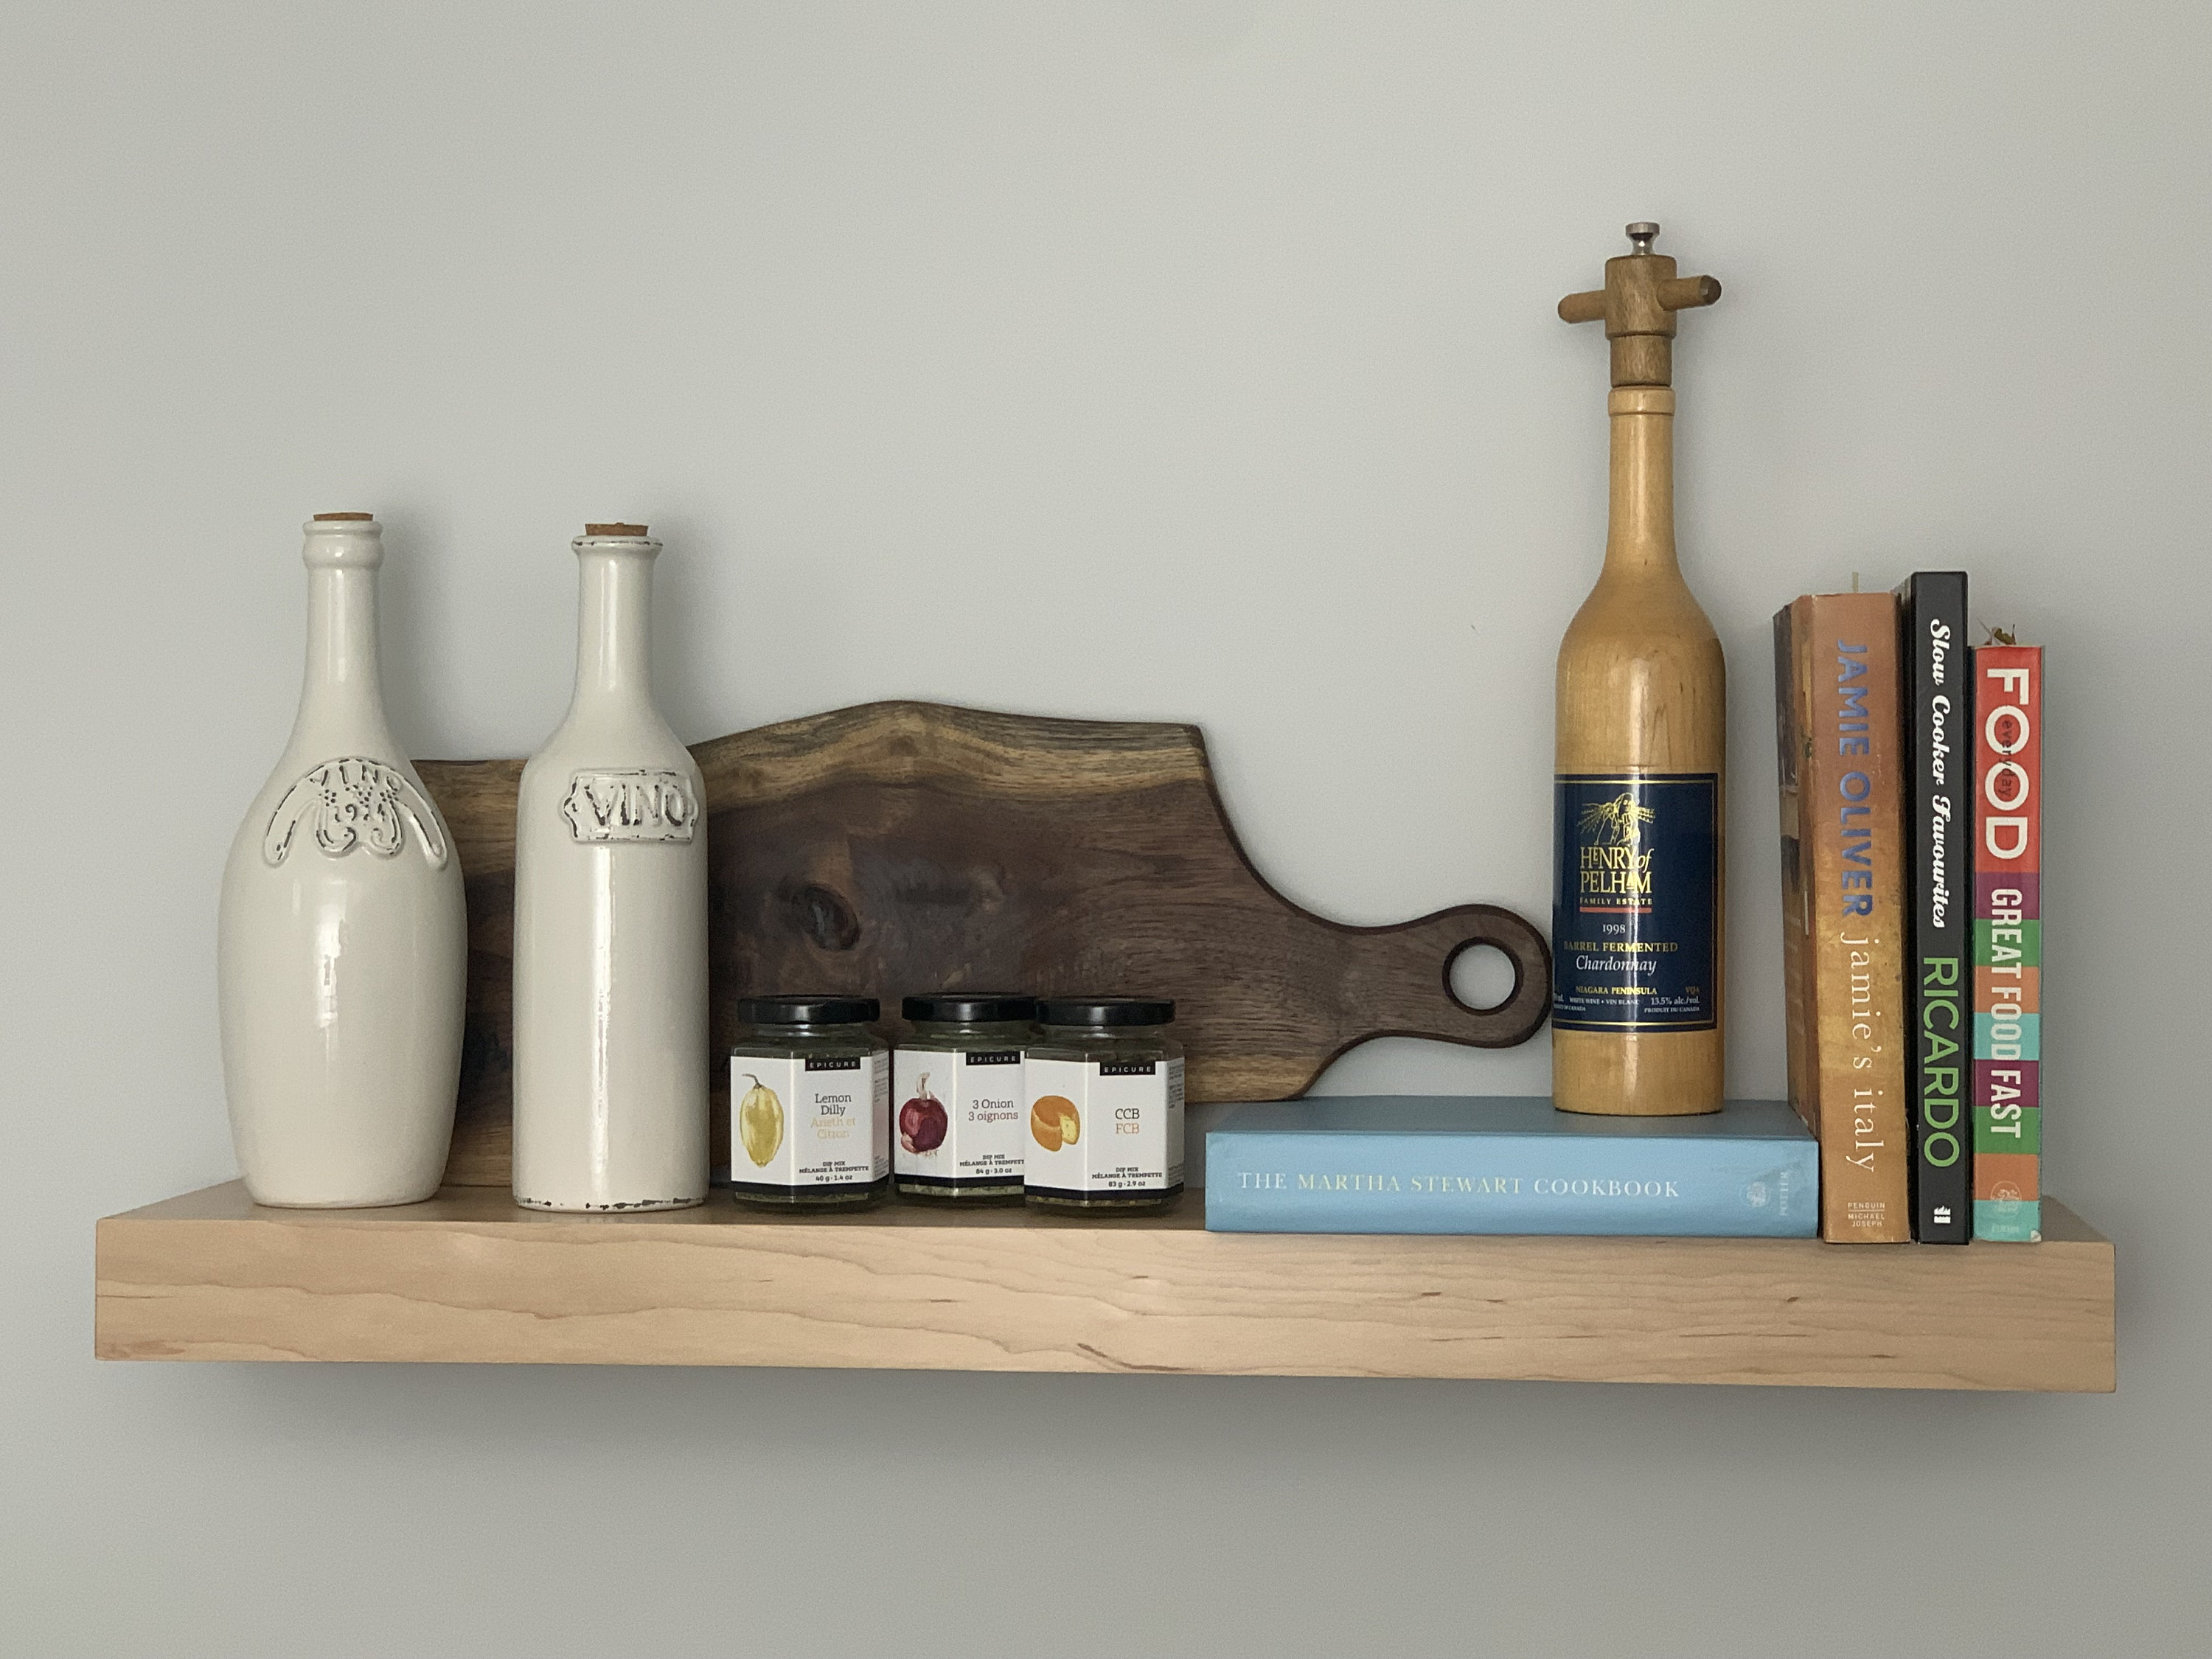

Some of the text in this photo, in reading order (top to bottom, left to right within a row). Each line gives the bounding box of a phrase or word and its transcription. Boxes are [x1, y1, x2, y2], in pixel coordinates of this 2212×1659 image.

[1985, 668, 2030, 859] FOOD
[1998, 720, 2015, 796] everyday
[1837, 639, 1873, 916] JAMIE OLIVER
[1930, 619, 1951, 928] Slow Cooker Favourites
[583, 782, 687, 827] VINO
[1580, 846, 1655, 874] HENRY of
[1580, 871, 1652, 894] PELHAM
[1603, 924, 1626, 936] 1998
[1564, 941, 1678, 953] BARREL FERMENTED
[1576, 955, 1657, 977] Chardonnay
[1576, 986, 1658, 995] NIAGARA PENINSULA
[1650, 997, 1672, 1005] 13.5%
[1989, 888, 2023, 1138] GREAT FOOD FAST
[1840, 932, 1884, 1172] jamie's italy
[1923, 957, 1960, 1167] RICARDO
[815, 1093, 852, 1104] Lemon
[973, 1099, 1014, 1109] 3 Onion
[821, 1105, 846, 1116] Dilly
[968, 1110, 1018, 1123] 3 oignons
[1115, 1108, 1140, 1119] CCB
[1115, 1123, 1139, 1134] FCB
[1238, 1172, 1679, 1197] THE MARTHA STEWART COOKBOOK
